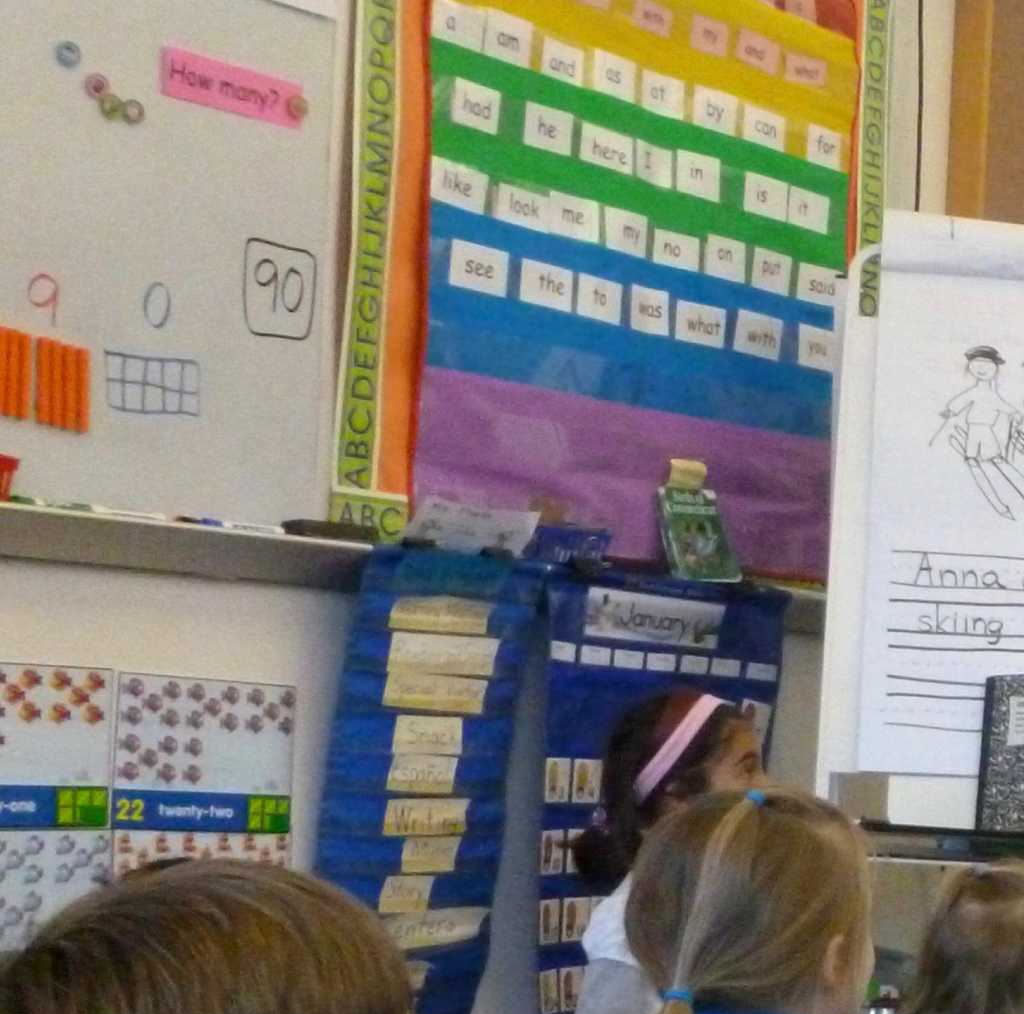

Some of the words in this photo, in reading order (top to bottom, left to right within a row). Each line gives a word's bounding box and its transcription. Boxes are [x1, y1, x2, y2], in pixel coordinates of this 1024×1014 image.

[169, 60, 211, 91] How
[217, 74, 280, 110] many?
[549, 56, 577, 78] and
[605, 67, 622, 85] as
[650, 83, 665, 99] at
[706, 101, 725, 122] by
[754, 120, 777, 139] can
[815, 134, 836, 154] for
[537, 113, 557, 139] he
[592, 137, 627, 166] here
[690, 165, 704, 181] in
[756, 188, 768, 203] is
[441, 167, 472, 198] like
[509, 193, 540, 219] look
[561, 207, 585, 225] me
[622, 224, 641, 246] my
[664, 241, 681, 257] no
[717, 247, 733, 262] on
[808, 278, 836, 297] said
[254, 258, 305, 314] 90
[464, 258, 495, 280] see
[538, 272, 566, 297] the
[592, 287, 608, 307] to
[638, 303, 662, 319] was
[686, 312, 722, 336] what
[747, 329, 777, 349] with
[913, 551, 1006, 590] Anna
[619, 602, 690, 641] January
[917, 602, 1004, 646] skiing
[115, 799, 146, 821] 22
[158, 803, 235, 820] twenty-two
